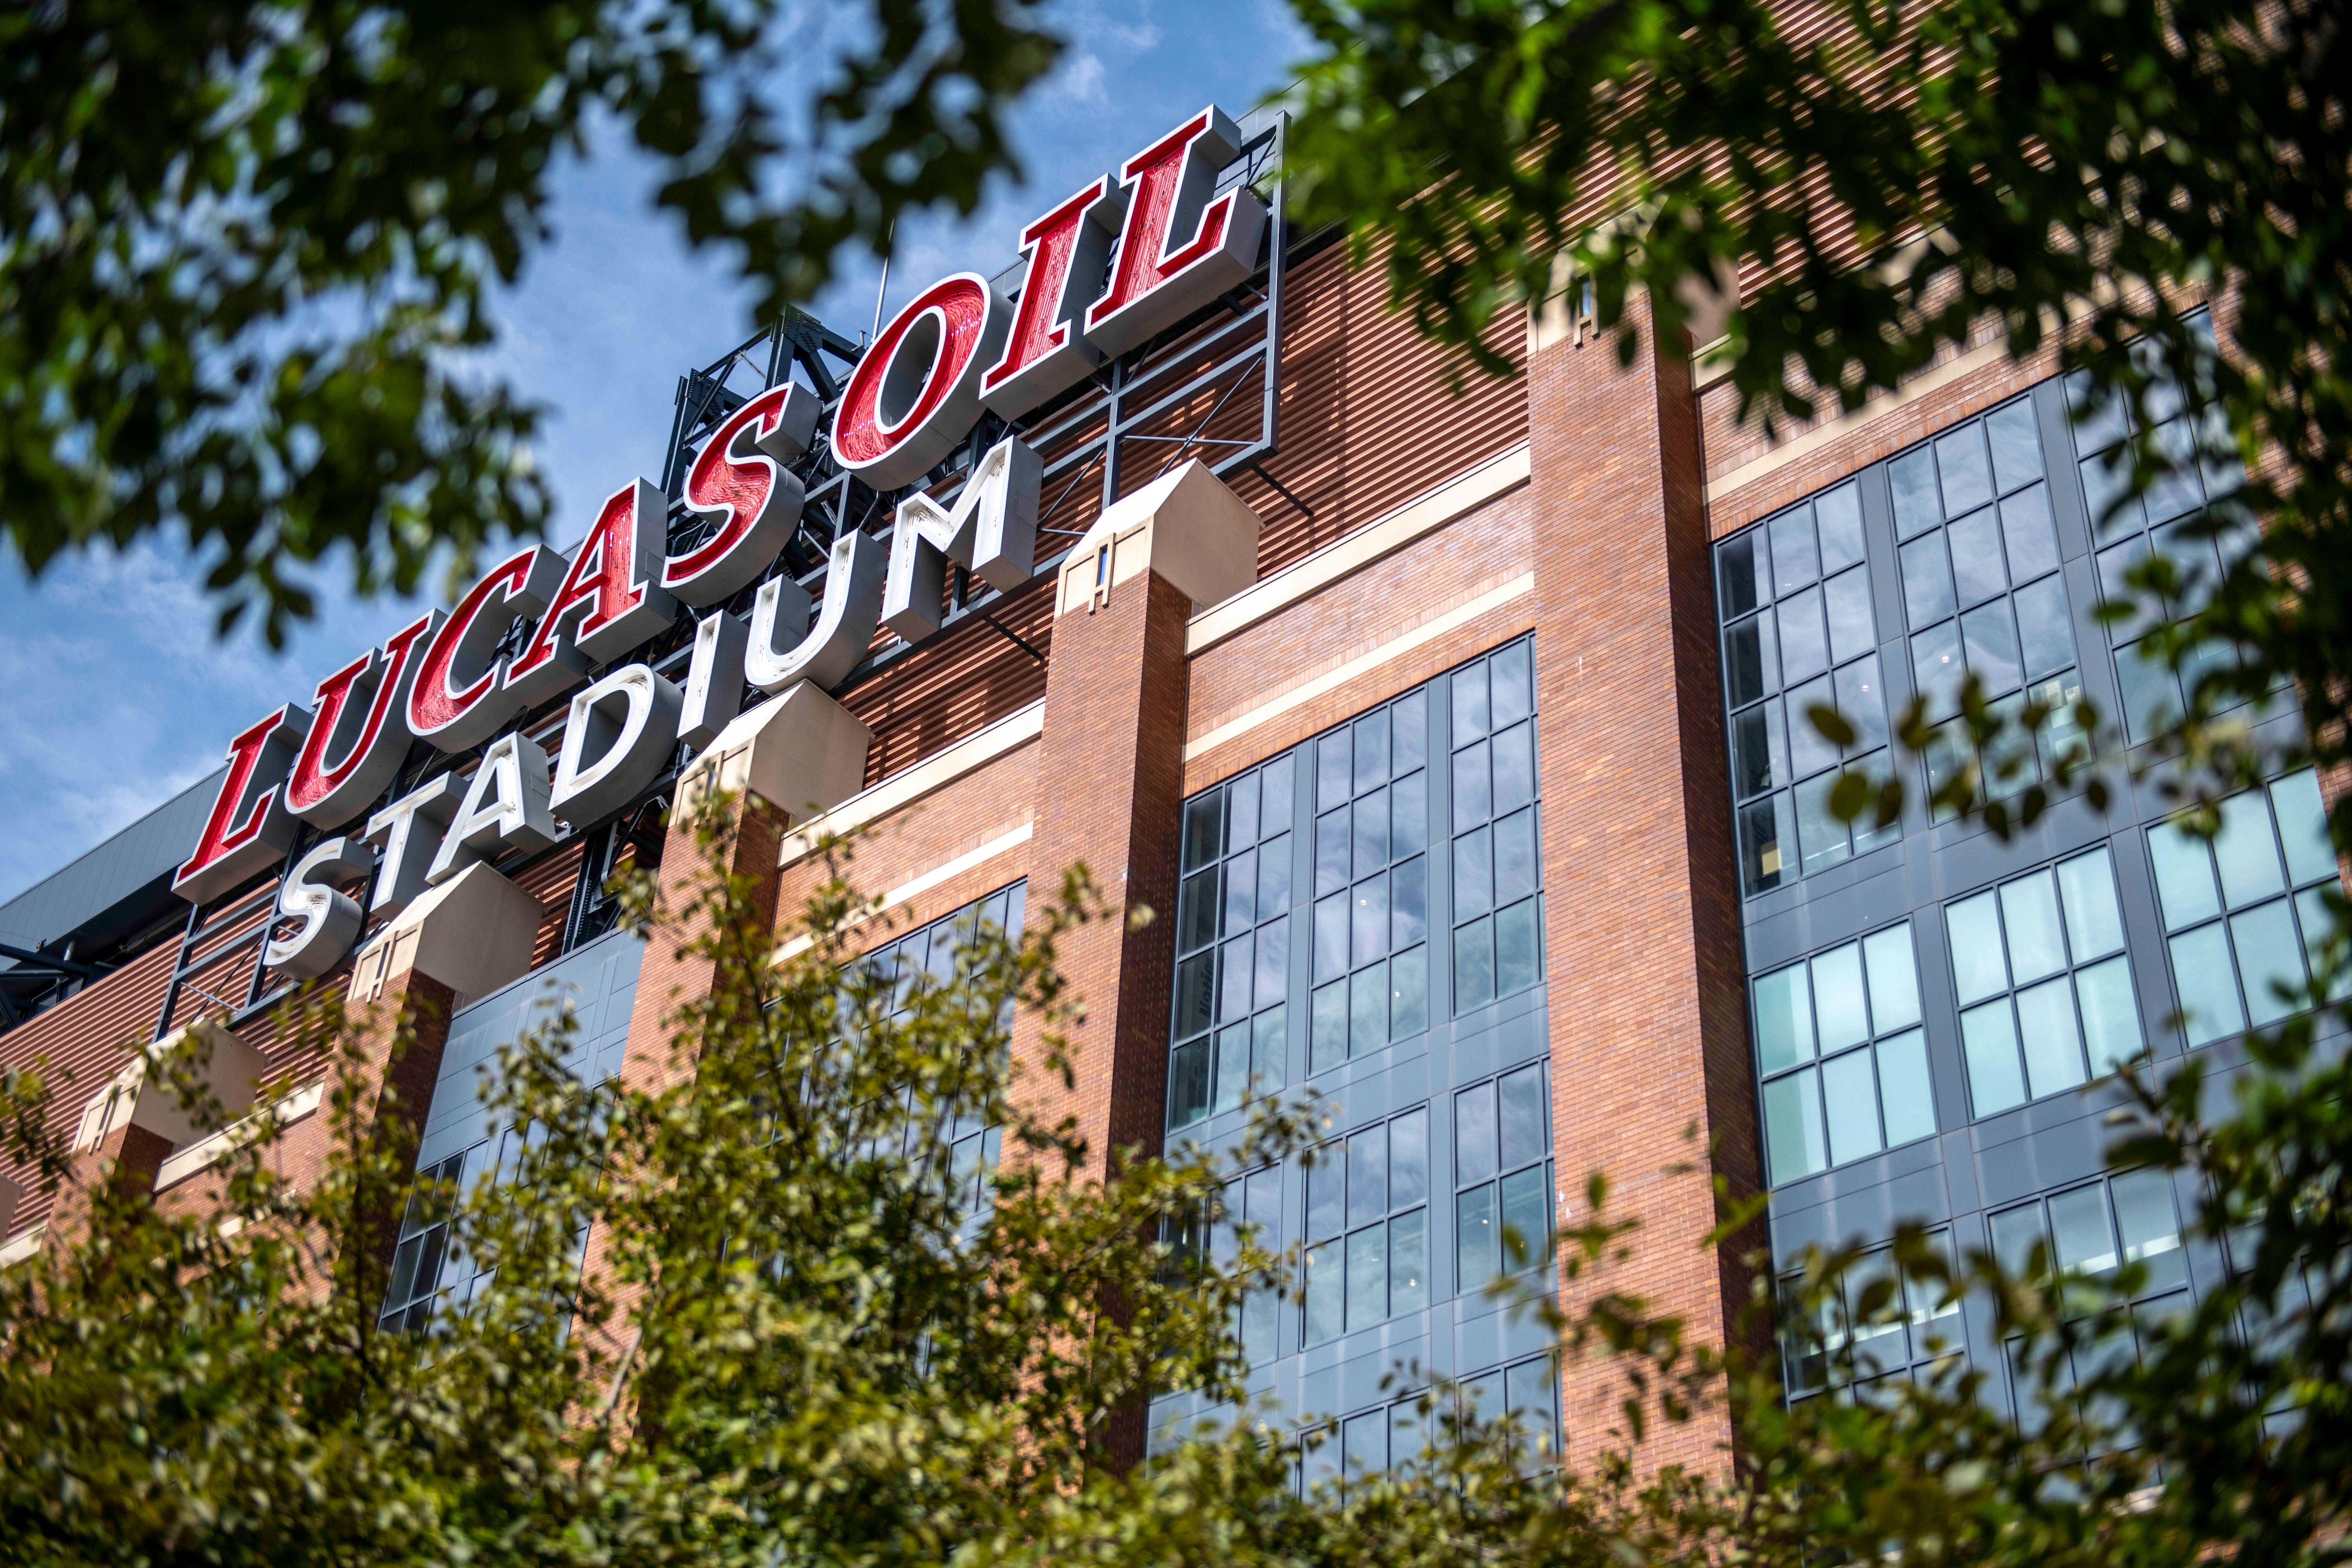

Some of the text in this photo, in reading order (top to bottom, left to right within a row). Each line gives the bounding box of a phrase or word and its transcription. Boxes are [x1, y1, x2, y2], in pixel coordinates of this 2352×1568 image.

[173, 105, 1239, 895] LUCAS OIL
[265, 437, 1014, 967] STADIUM
